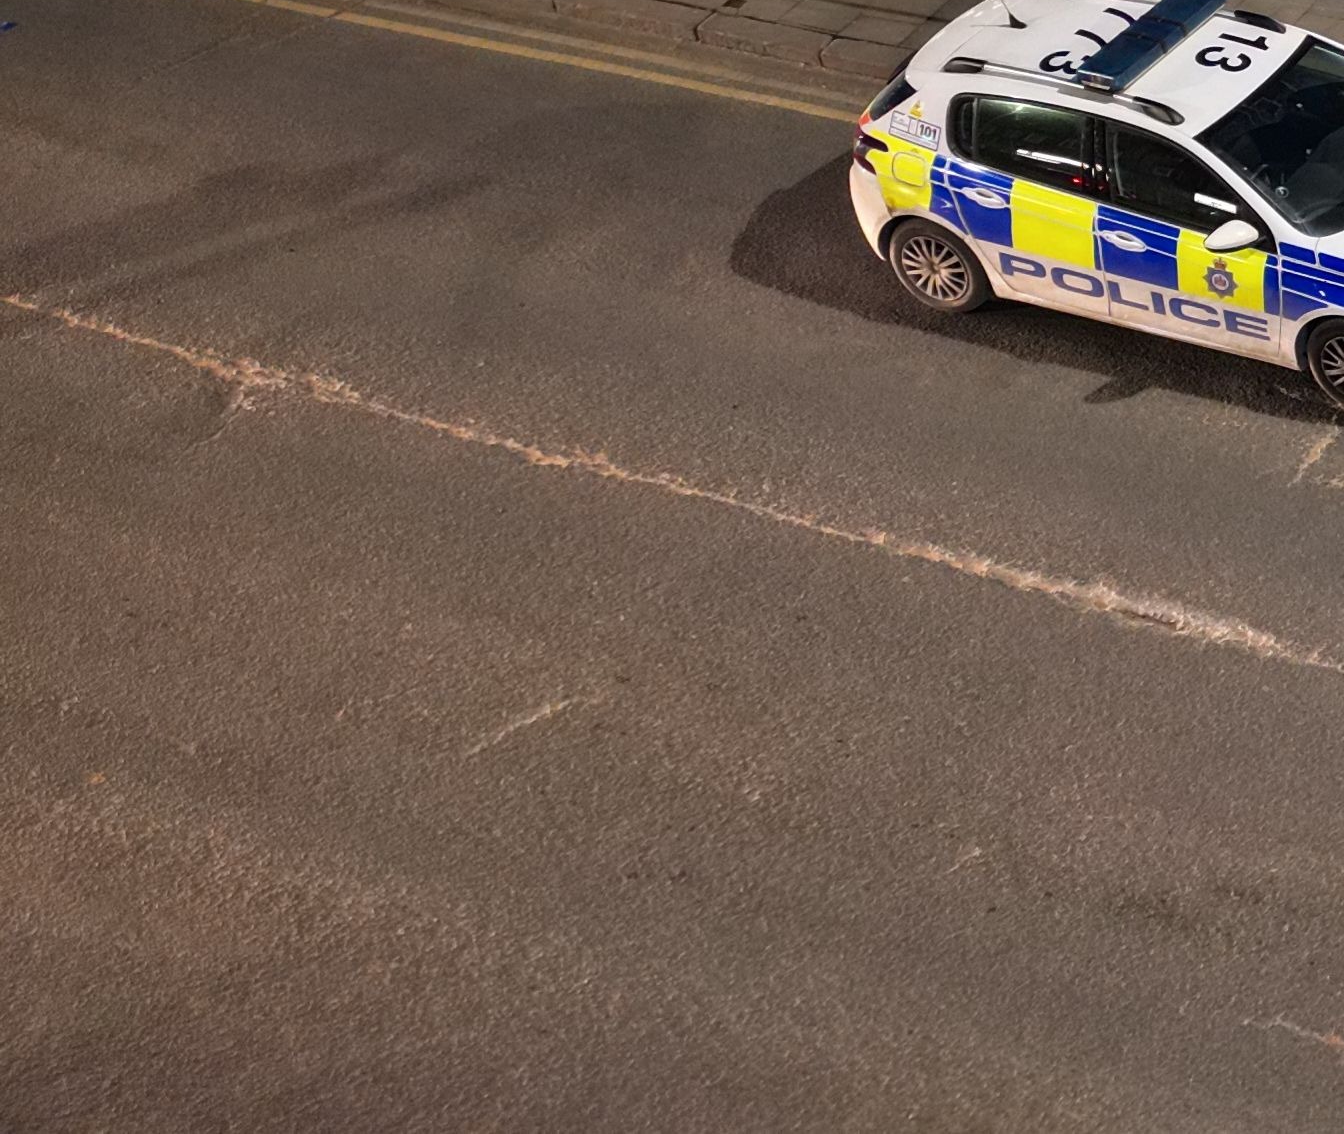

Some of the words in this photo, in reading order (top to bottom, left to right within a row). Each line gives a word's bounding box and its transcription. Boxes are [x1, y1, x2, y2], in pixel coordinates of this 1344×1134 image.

[1195, 33, 1271, 72] 13
[920, 124, 937, 140] 101
[999, 252, 1271, 341] POLICE
